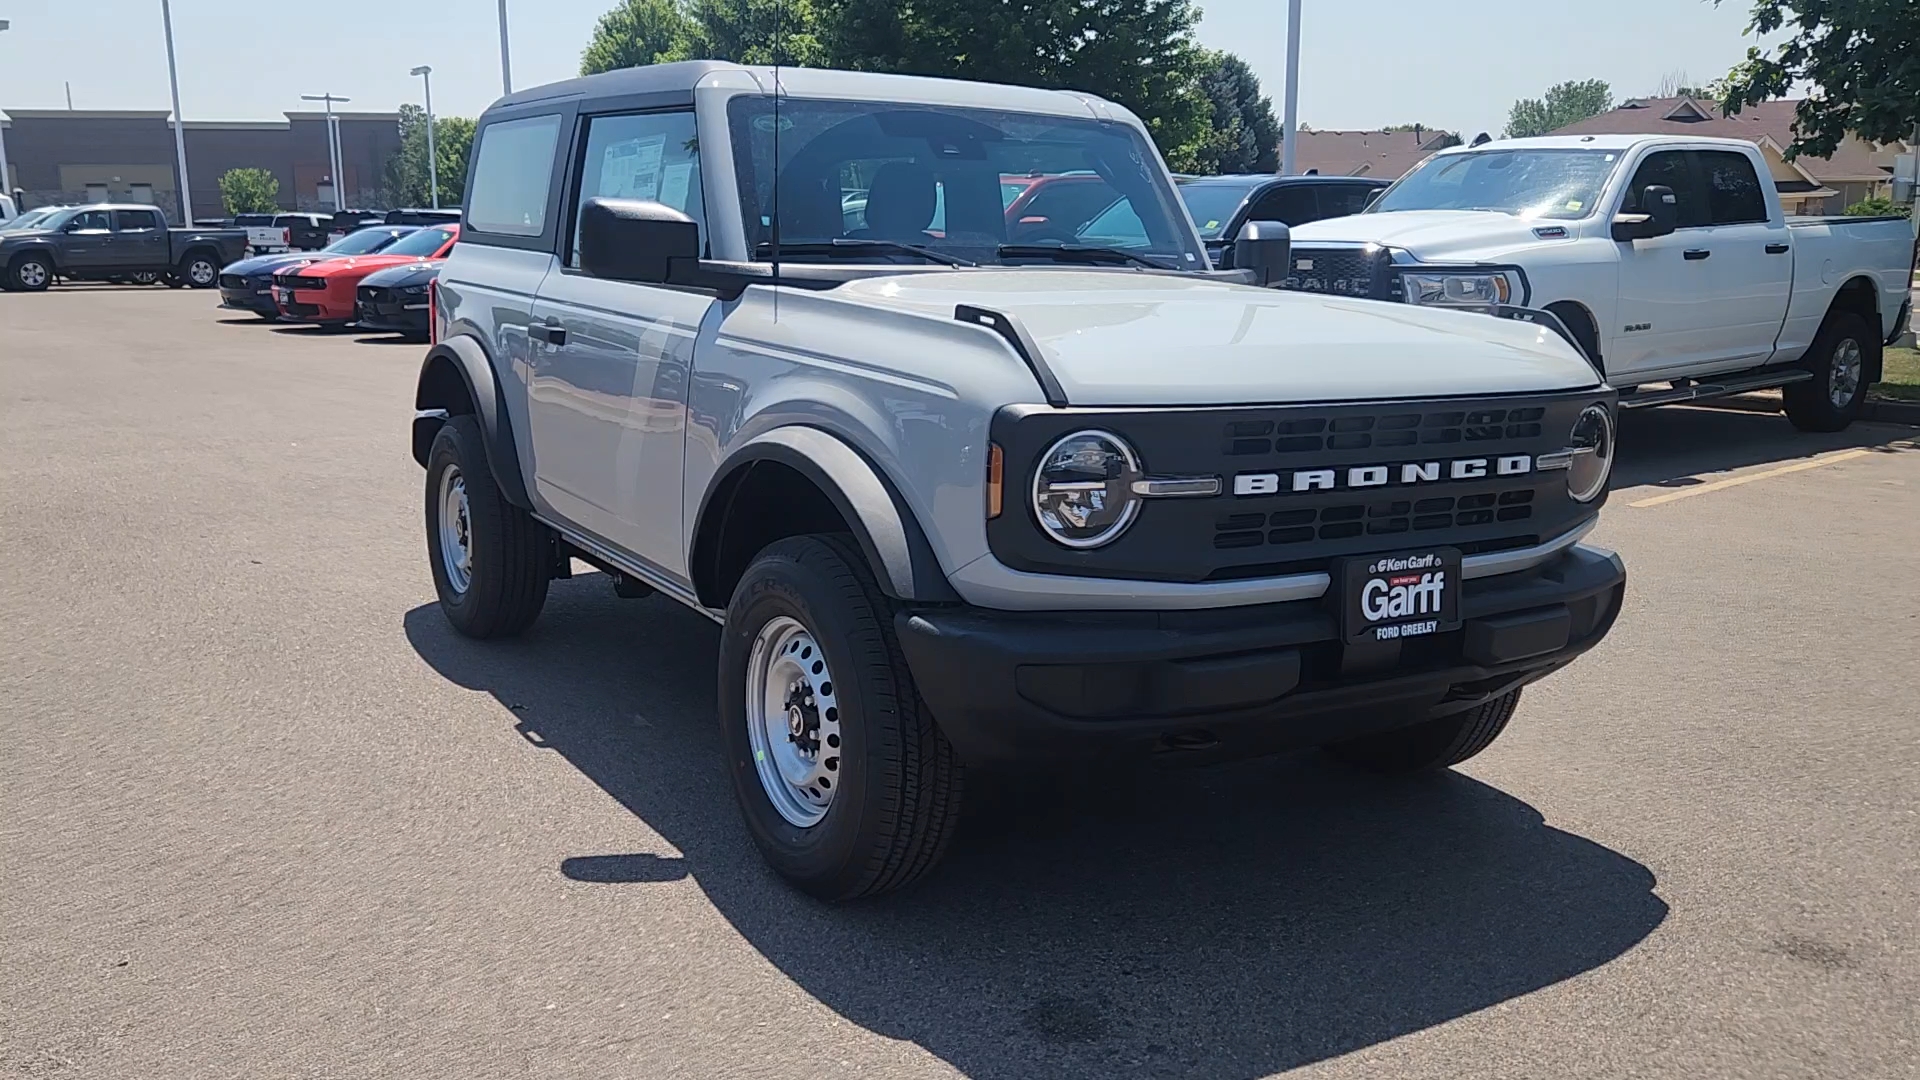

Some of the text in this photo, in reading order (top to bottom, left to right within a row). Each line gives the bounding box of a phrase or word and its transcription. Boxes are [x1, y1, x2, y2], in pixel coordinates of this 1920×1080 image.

[1623, 322, 1652, 333] RAM
[1233, 454, 1532, 495] BRONCO
[1407, 554, 1434, 569] Garff
[1361, 571, 1445, 622] Garff
[1376, 620, 1438, 640] FORD GREELEY
